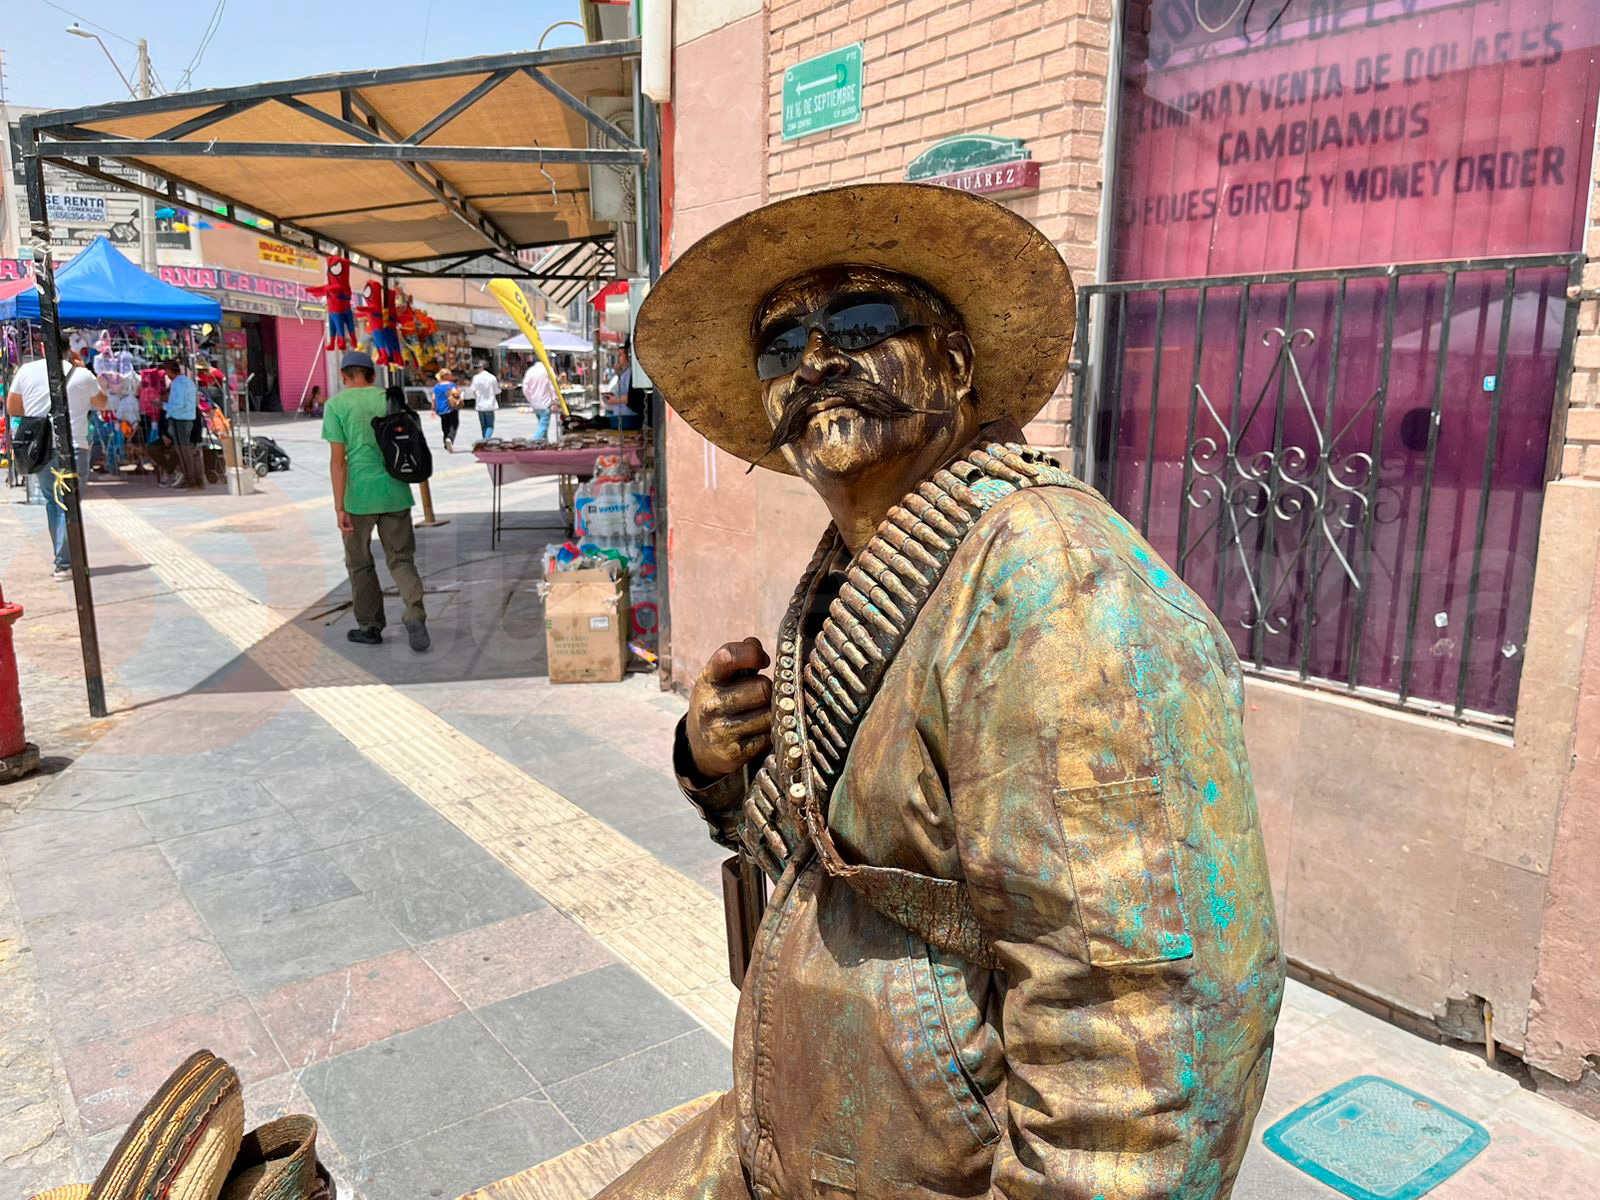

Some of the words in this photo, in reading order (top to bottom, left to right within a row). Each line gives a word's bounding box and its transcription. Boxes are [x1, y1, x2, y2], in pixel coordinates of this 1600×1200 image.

[803, 97, 813, 115] DE
[813, 83, 857, 113] SEPTIEMBRE
[1258, 63, 1344, 111] VENTA
[1354, 53, 1392, 95] DE
[1218, 100, 1430, 167] CAMBIAMOS
[45, 194, 60, 205] SE
[63, 195, 104, 208] RENTA
[1228, 175, 1312, 217] GIROS
[1319, 174, 1338, 207] Y
[1344, 160, 1450, 205] MONEY
[1455, 146, 1565, 195] ORDER
[47, 204, 65, 212] OCAL
